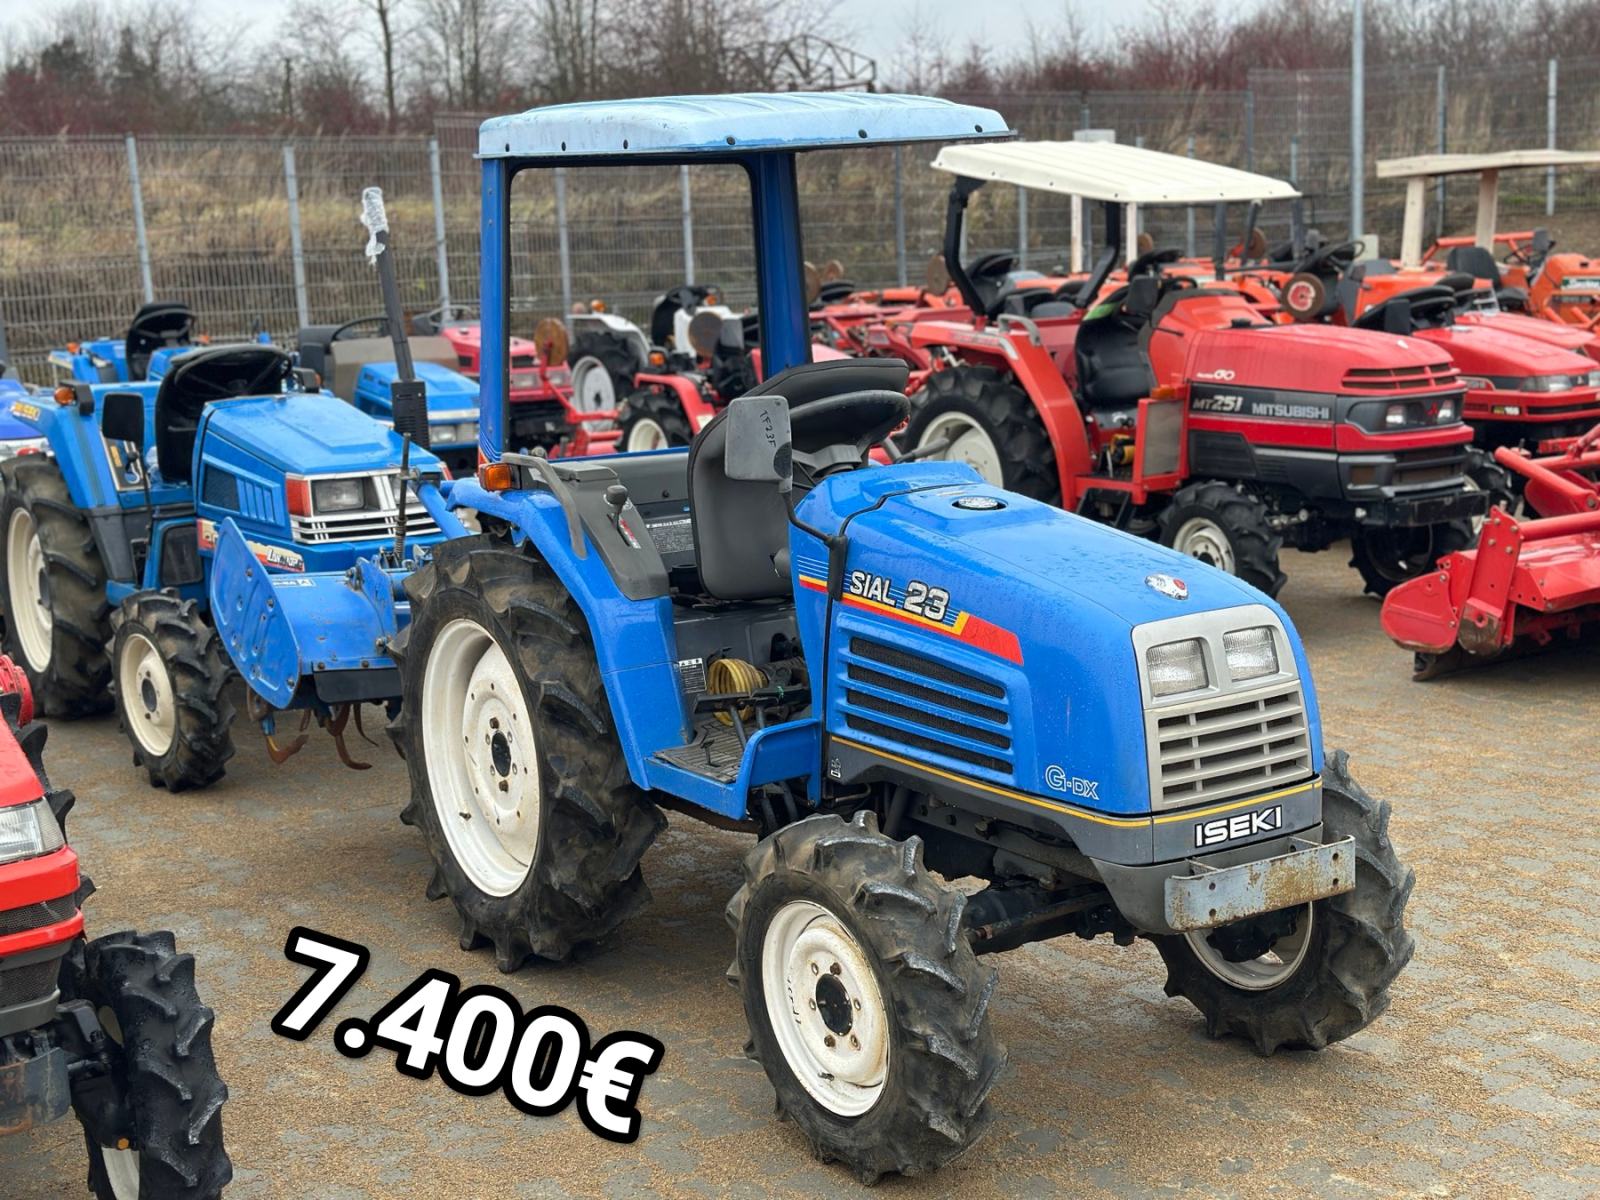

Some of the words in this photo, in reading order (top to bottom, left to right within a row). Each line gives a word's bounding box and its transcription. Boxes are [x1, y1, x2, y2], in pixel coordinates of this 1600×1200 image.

[1251, 402, 1330, 420] MITSUBISHI
[848, 569, 897, 607] SIAL
[902, 579, 950, 622] 23
[1194, 804, 1283, 848] ISEKI
